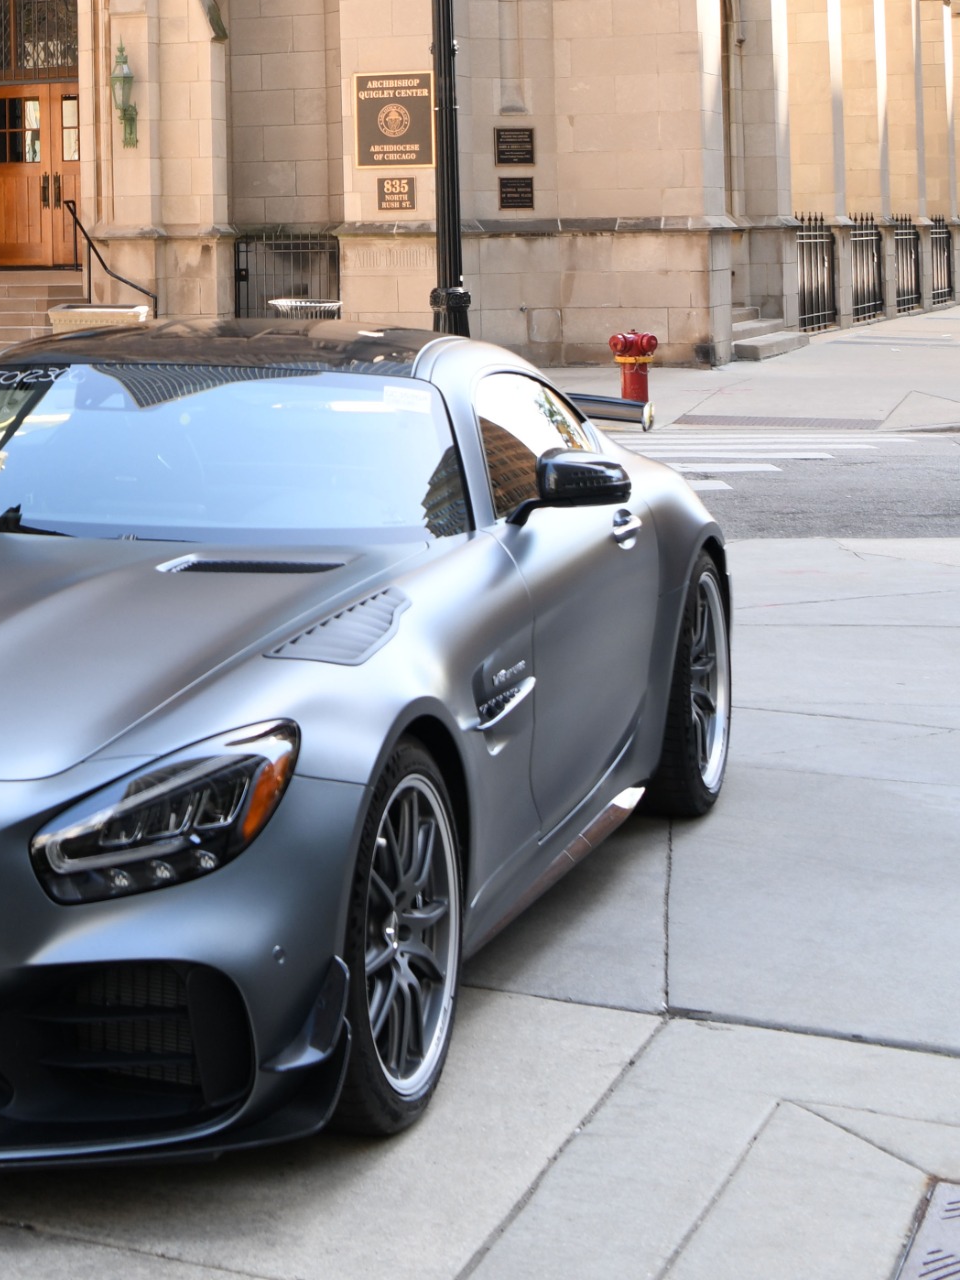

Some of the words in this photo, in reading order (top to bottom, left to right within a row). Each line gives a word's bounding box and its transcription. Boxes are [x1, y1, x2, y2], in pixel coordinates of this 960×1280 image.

[366, 78, 420, 89] ARCHBISHOP
[358, 89, 395, 100] QUIGLEY
[395, 88, 429, 98] CENTER
[369, 144, 420, 152] ARCHDIOCESE
[373, 153, 384, 161] OF
[384, 152, 416, 160] CHICAGO
[383, 179, 409, 194] 835
[381, 201, 400, 209] RUSH
